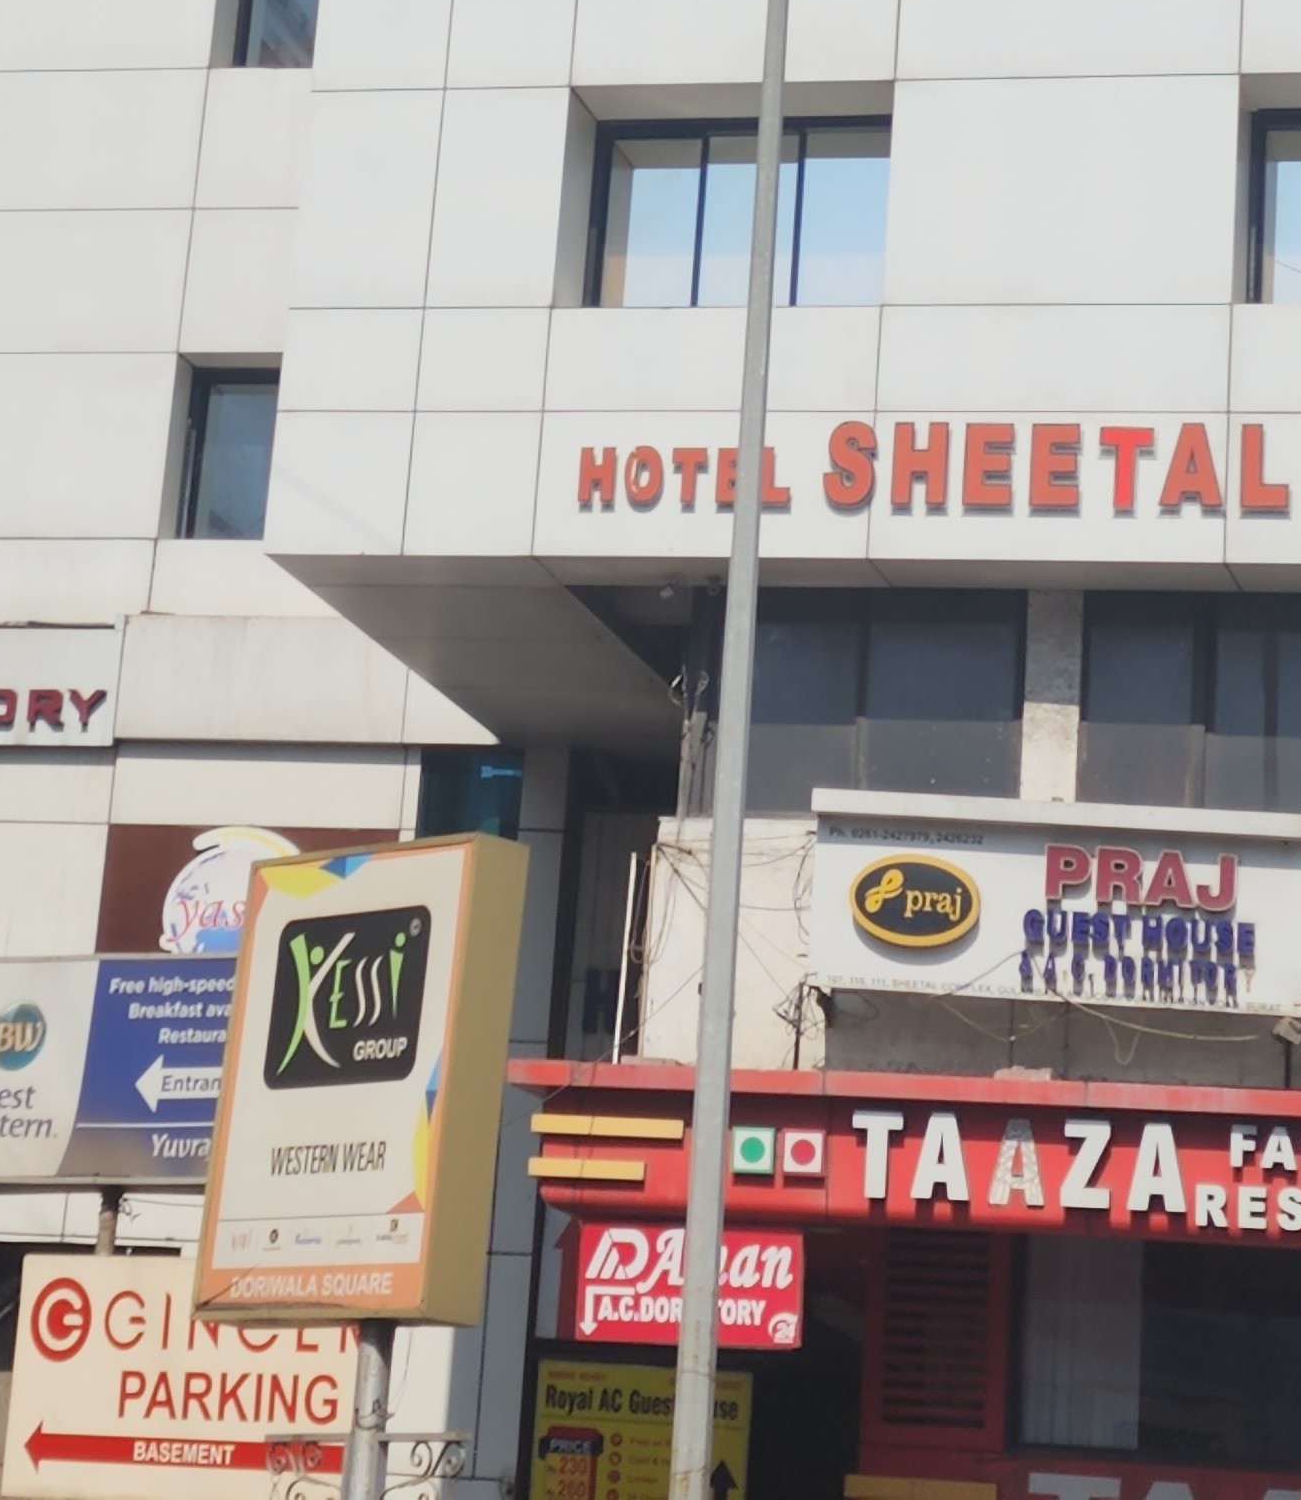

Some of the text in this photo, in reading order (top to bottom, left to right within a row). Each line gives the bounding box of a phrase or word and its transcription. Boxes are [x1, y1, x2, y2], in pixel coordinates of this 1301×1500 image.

[577, 445, 791, 505] HOTEL
[822, 420, 1290, 509] SHEETAL
[1044, 843, 1239, 912] PRAJ
[903, 886, 963, 921] praj
[1023, 908, 1256, 956] GUEST HOUSE
[109, 977, 146, 995] Free
[128, 1000, 203, 1020] Breakfast
[353, 1036, 408, 1061] GROUP
[270, 1139, 387, 1177] WESTERN WEAR
[852, 1110, 1187, 1213] TAAZA
[229, 1271, 394, 1299] DORIWALA SQUARE
[117, 1369, 339, 1426] PARKING
[544, 1384, 594, 1415] Royal
[598, 1387, 624, 1413] AC
[131, 1439, 236, 1466] BASEMENT
